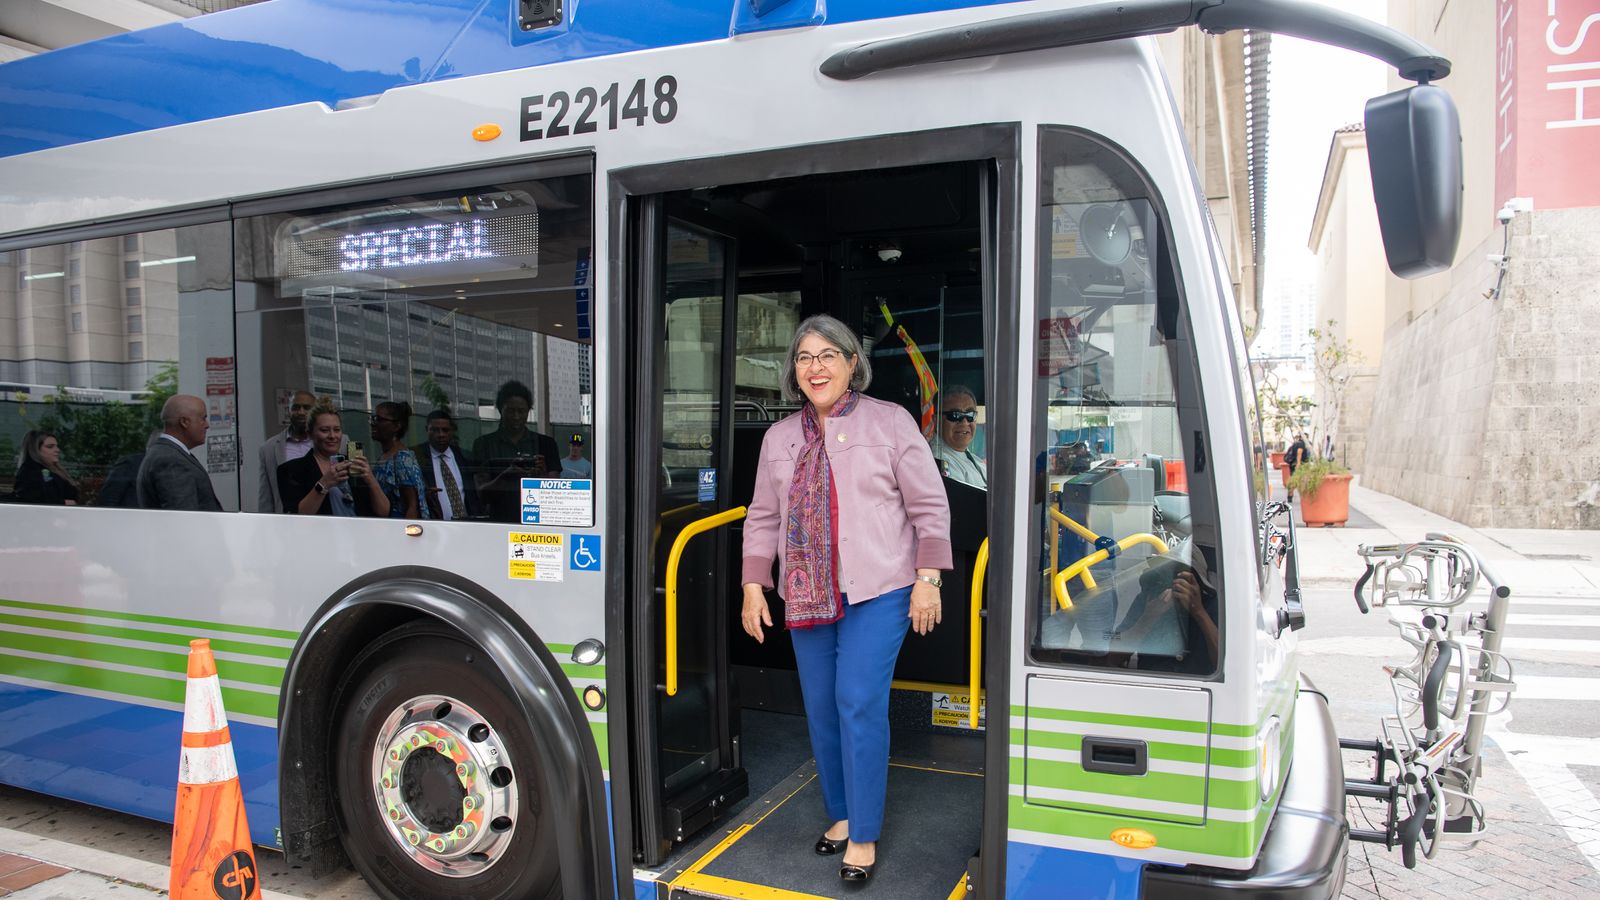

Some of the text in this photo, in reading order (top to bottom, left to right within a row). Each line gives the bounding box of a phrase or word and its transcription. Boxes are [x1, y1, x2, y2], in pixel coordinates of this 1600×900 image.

[519, 74, 678, 143] E22148
[339, 218, 494, 272] SPECIAL
[540, 481, 572, 489] NOTICE
[520, 535, 559, 543] CAUTION
